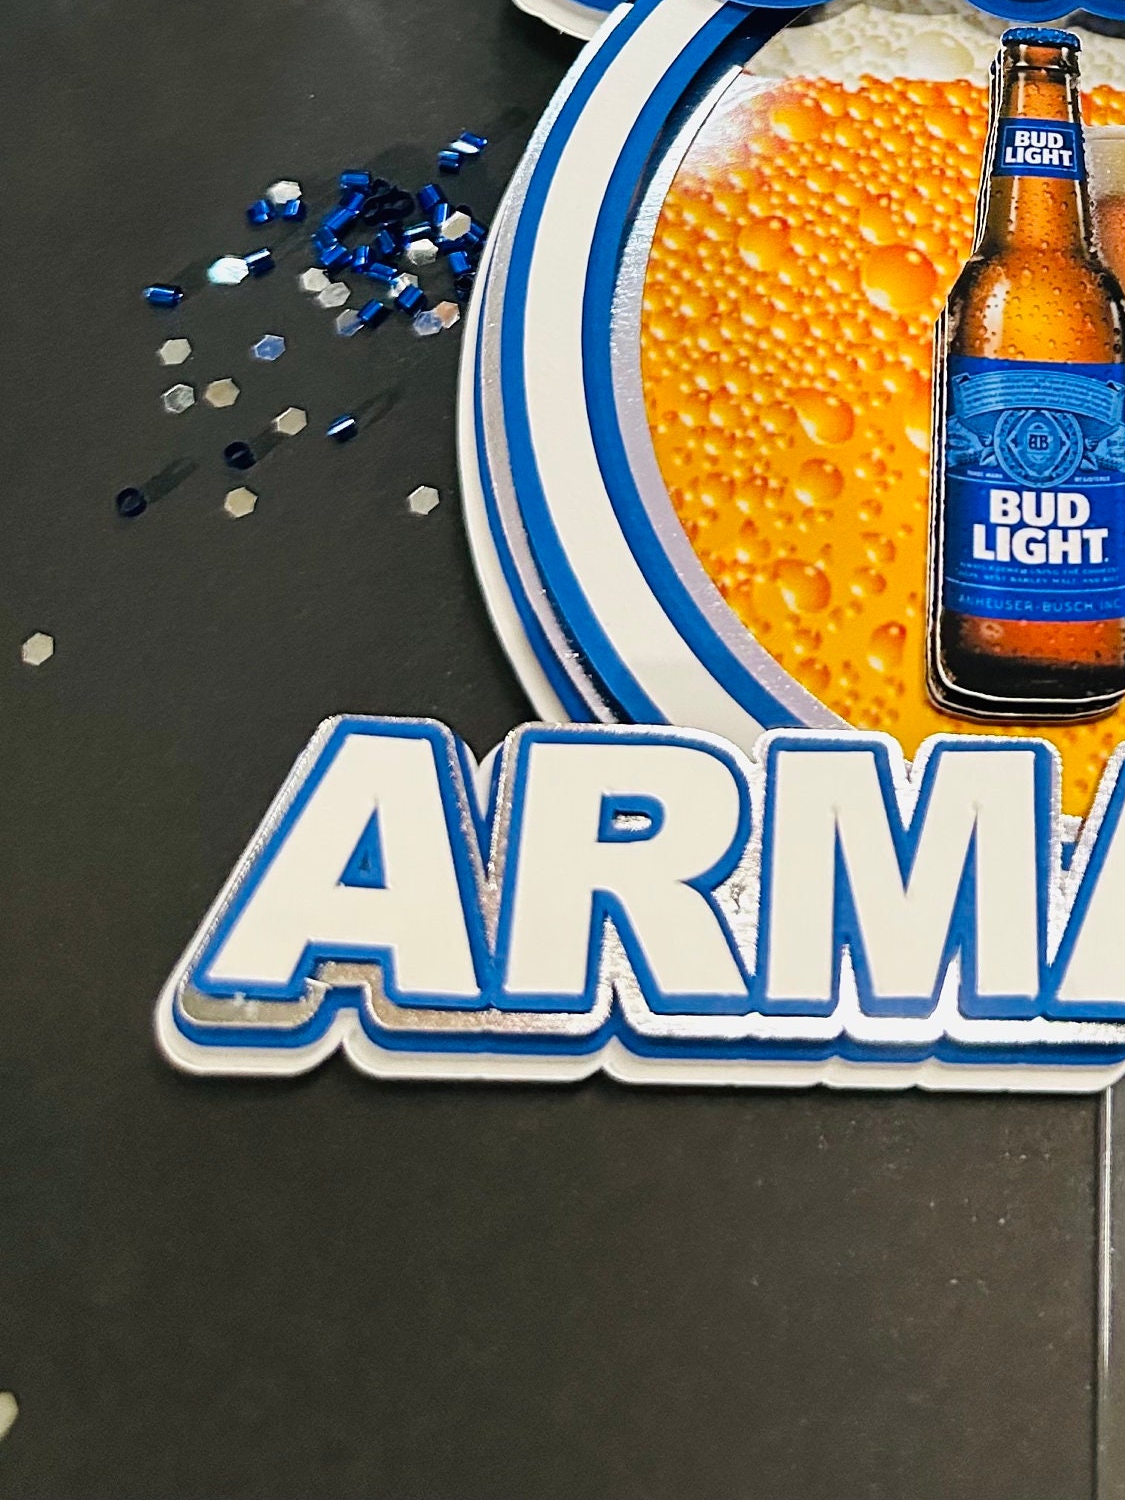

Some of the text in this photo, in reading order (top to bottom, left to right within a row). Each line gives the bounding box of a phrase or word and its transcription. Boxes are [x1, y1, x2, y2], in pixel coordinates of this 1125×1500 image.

[1014, 130, 1064, 150] BUD
[1004, 147, 1074, 167] LIGHT
[989, 489, 1091, 528] BUD
